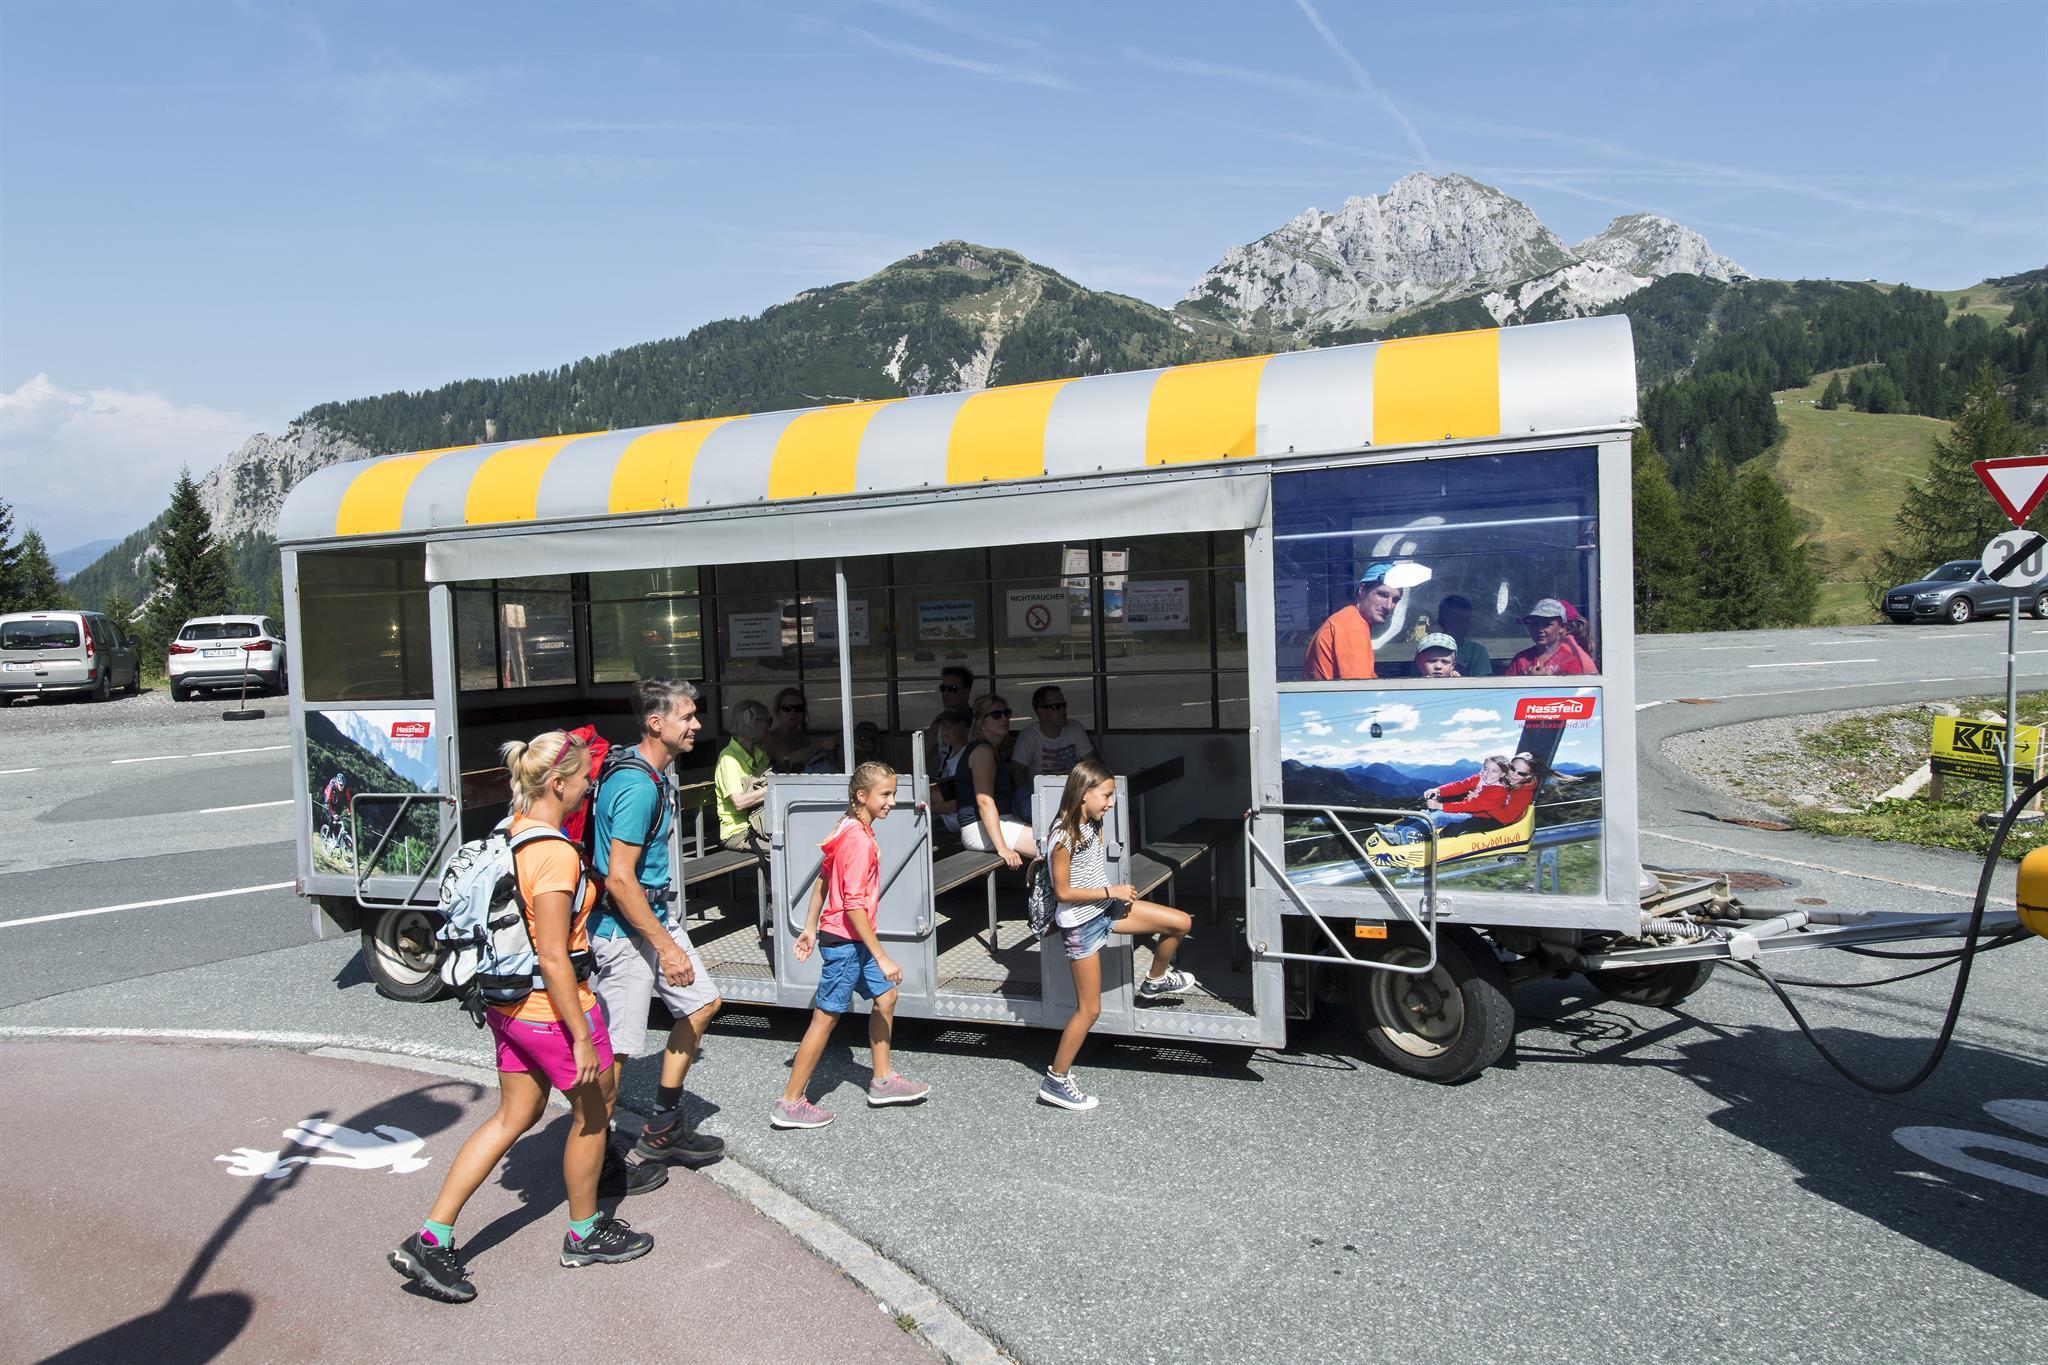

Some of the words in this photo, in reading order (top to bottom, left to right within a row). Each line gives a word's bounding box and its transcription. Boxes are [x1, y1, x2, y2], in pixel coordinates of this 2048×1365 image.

[1993, 538, 2043, 578] 30
[1010, 593, 1065, 602] NICHTRAUCHER
[1526, 702, 1584, 714] Nassfeld
[396, 726, 425, 734] Nassfeld
